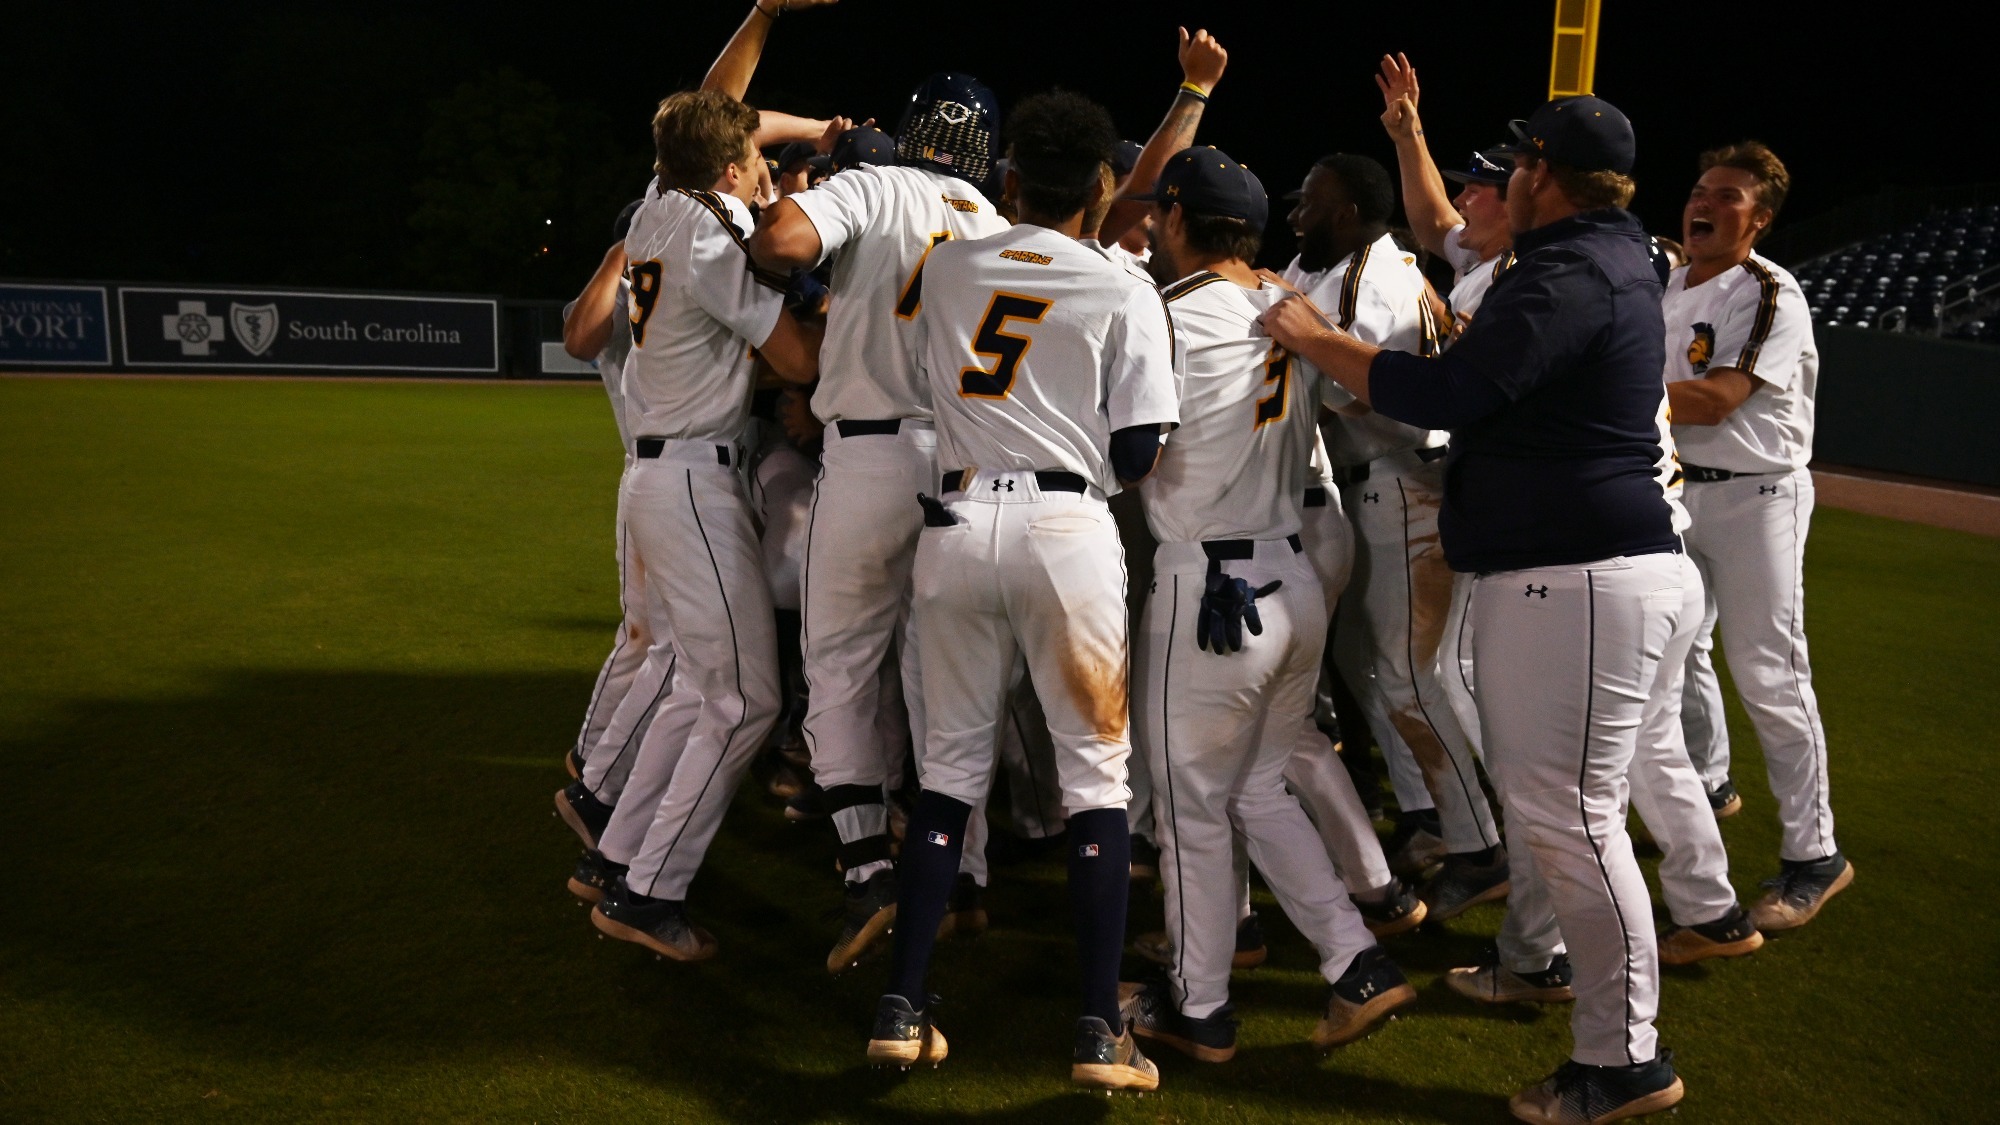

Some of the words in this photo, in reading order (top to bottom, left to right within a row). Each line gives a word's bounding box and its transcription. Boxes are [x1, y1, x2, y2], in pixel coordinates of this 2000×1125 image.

[942, 192, 979, 213] RTANS
[999, 249, 1054, 266] SPARTANS
[0, 313, 94, 339] PORT
[288, 321, 357, 341] South
[363, 322, 462, 345] Carolina
[958, 289, 1056, 401] 5
